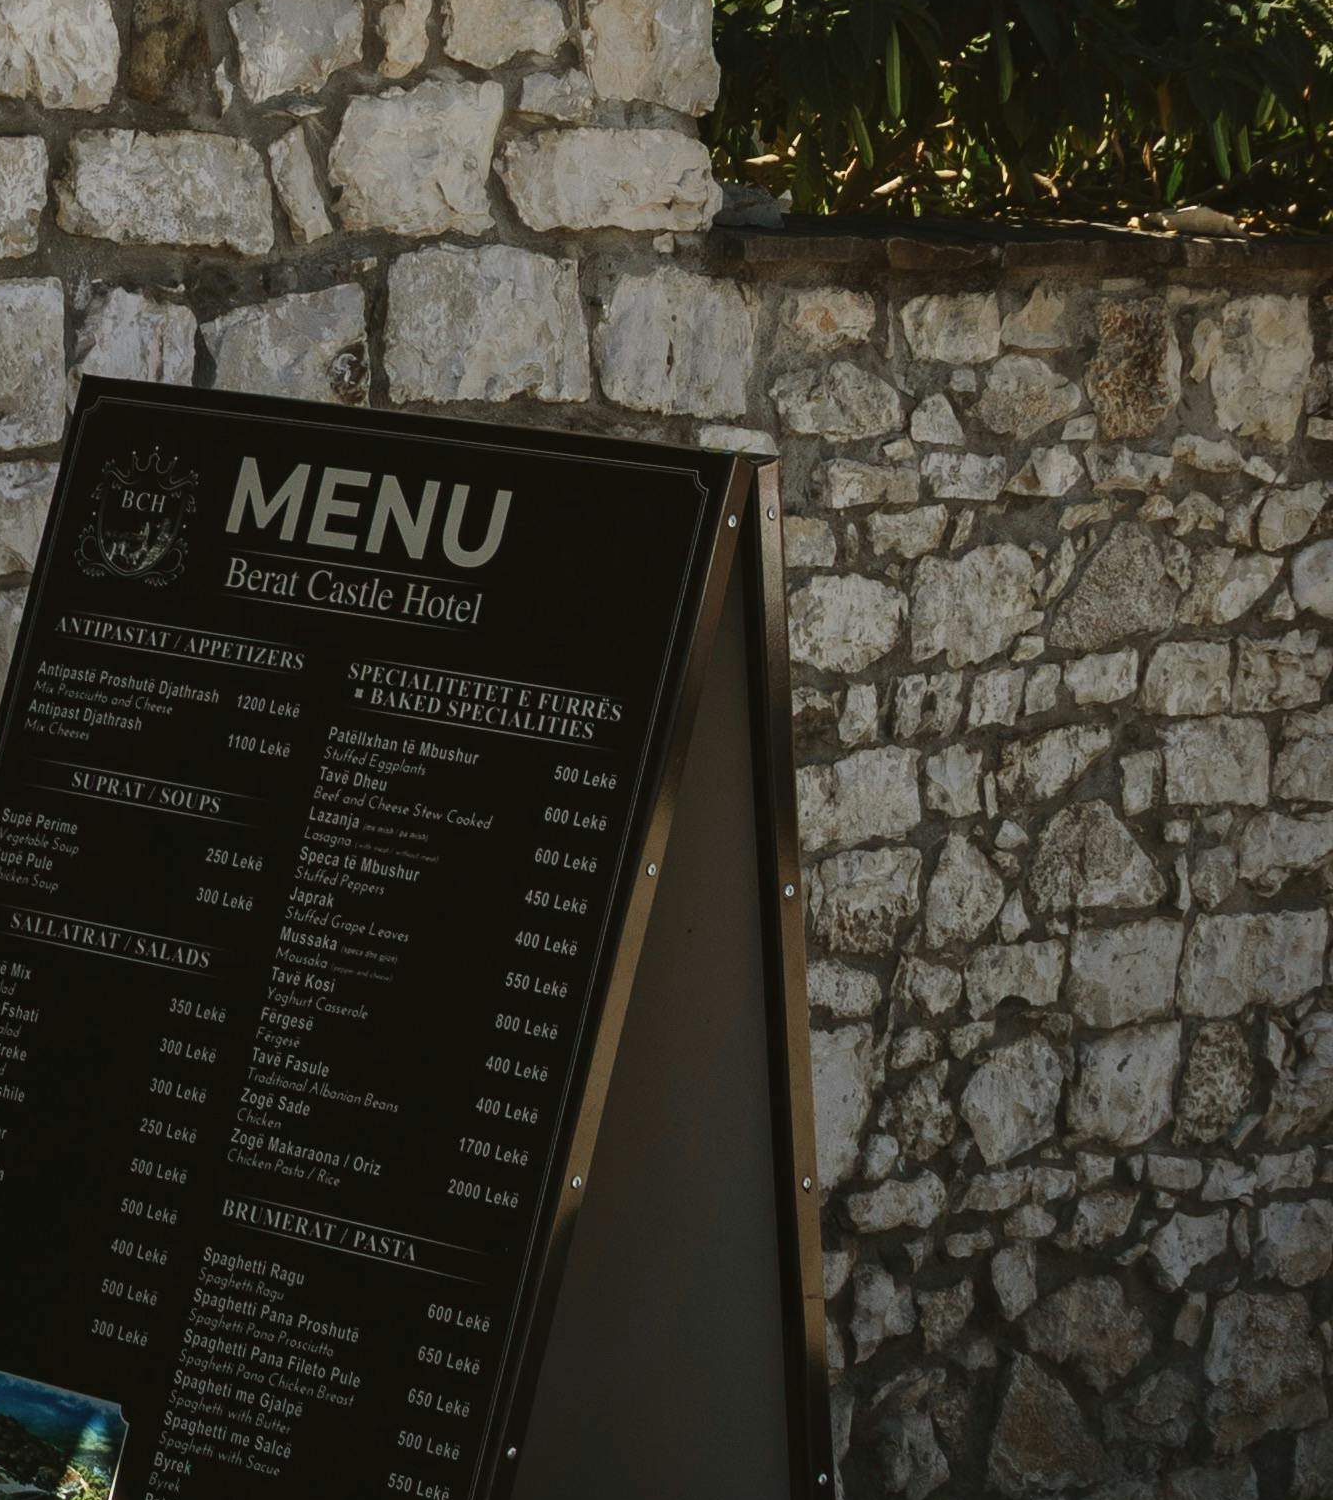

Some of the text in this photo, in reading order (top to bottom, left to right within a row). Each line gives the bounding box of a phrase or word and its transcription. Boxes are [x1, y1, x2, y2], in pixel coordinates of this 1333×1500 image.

[120, 488, 167, 514] BCH
[224, 455, 514, 569] MENU
[223, 556, 484, 625] Berat Castle Hotel
[52, 614, 173, 650] ANTIPASTAT
[181, 634, 307, 672] APPETIZERS
[157, 679, 221, 704] Djathrash
[236, 693, 267, 713] 1200
[346, 662, 625, 723] SPECIALITETET E FURRËS
[27, 697, 143, 732] Antipast Djathrash
[369, 687, 596, 740] BAKED SPECIALITIES
[227, 732, 258, 753] 1100
[417, 740, 481, 766] Mbushur
[351, 770, 389, 793] Dheu
[552, 764, 580, 784] 500
[68, 769, 147, 802] SUPRAT
[156, 785, 224, 816] SOUPS
[34, 812, 79, 836] Perime
[307, 805, 361, 832] Lazanja
[24, 851, 54, 872] Pule
[204, 846, 230, 866] 250
[298, 844, 341, 868] Speca
[359, 855, 422, 883] Mbushur
[533, 846, 561, 867] 600
[195, 886, 220, 906] 300
[288, 885, 335, 909] Japrak
[8, 910, 123, 952] SALLATRAT
[132, 936, 213, 971] SALADS
[278, 925, 339, 952] Mussaka
[513, 929, 541, 950] 400
[9, 961, 33, 981] Mix
[303, 972, 337, 994] Kosi
[0, 1000, 40, 1024] Fshati
[168, 996, 193, 1017] 350
[494, 1012, 522, 1033] 800
[283, 1053, 331, 1079] Fasule
[148, 1076, 174, 1097] 300
[276, 1094, 312, 1118] Sade
[474, 1096, 502, 1117] 400
[129, 1156, 155, 1177] 500
[266, 1134, 341, 1167] Makaraona
[352, 1155, 383, 1177] Oriz
[446, 1177, 482, 1201] 2000
[220, 1197, 338, 1244] BRUMERAT
[350, 1228, 420, 1264] PASTA
[109, 1238, 135, 1258] 400
[202, 1245, 306, 1288] Spaghetti Ragu
[192, 1286, 258, 1318] Spaghetti
[259, 1303, 295, 1327] Pana
[90, 1317, 116, 1338] 300
[182, 1327, 362, 1389] Spaghetti Pana Fileto Pule
[416, 1344, 444, 1366] 650
[234, 1388, 256, 1406] me
[162, 1409, 229, 1442] Spaghetti
[229, 1431, 251, 1448] me
[396, 1429, 424, 1451] 500
[152, 1450, 193, 1477] Byrek
